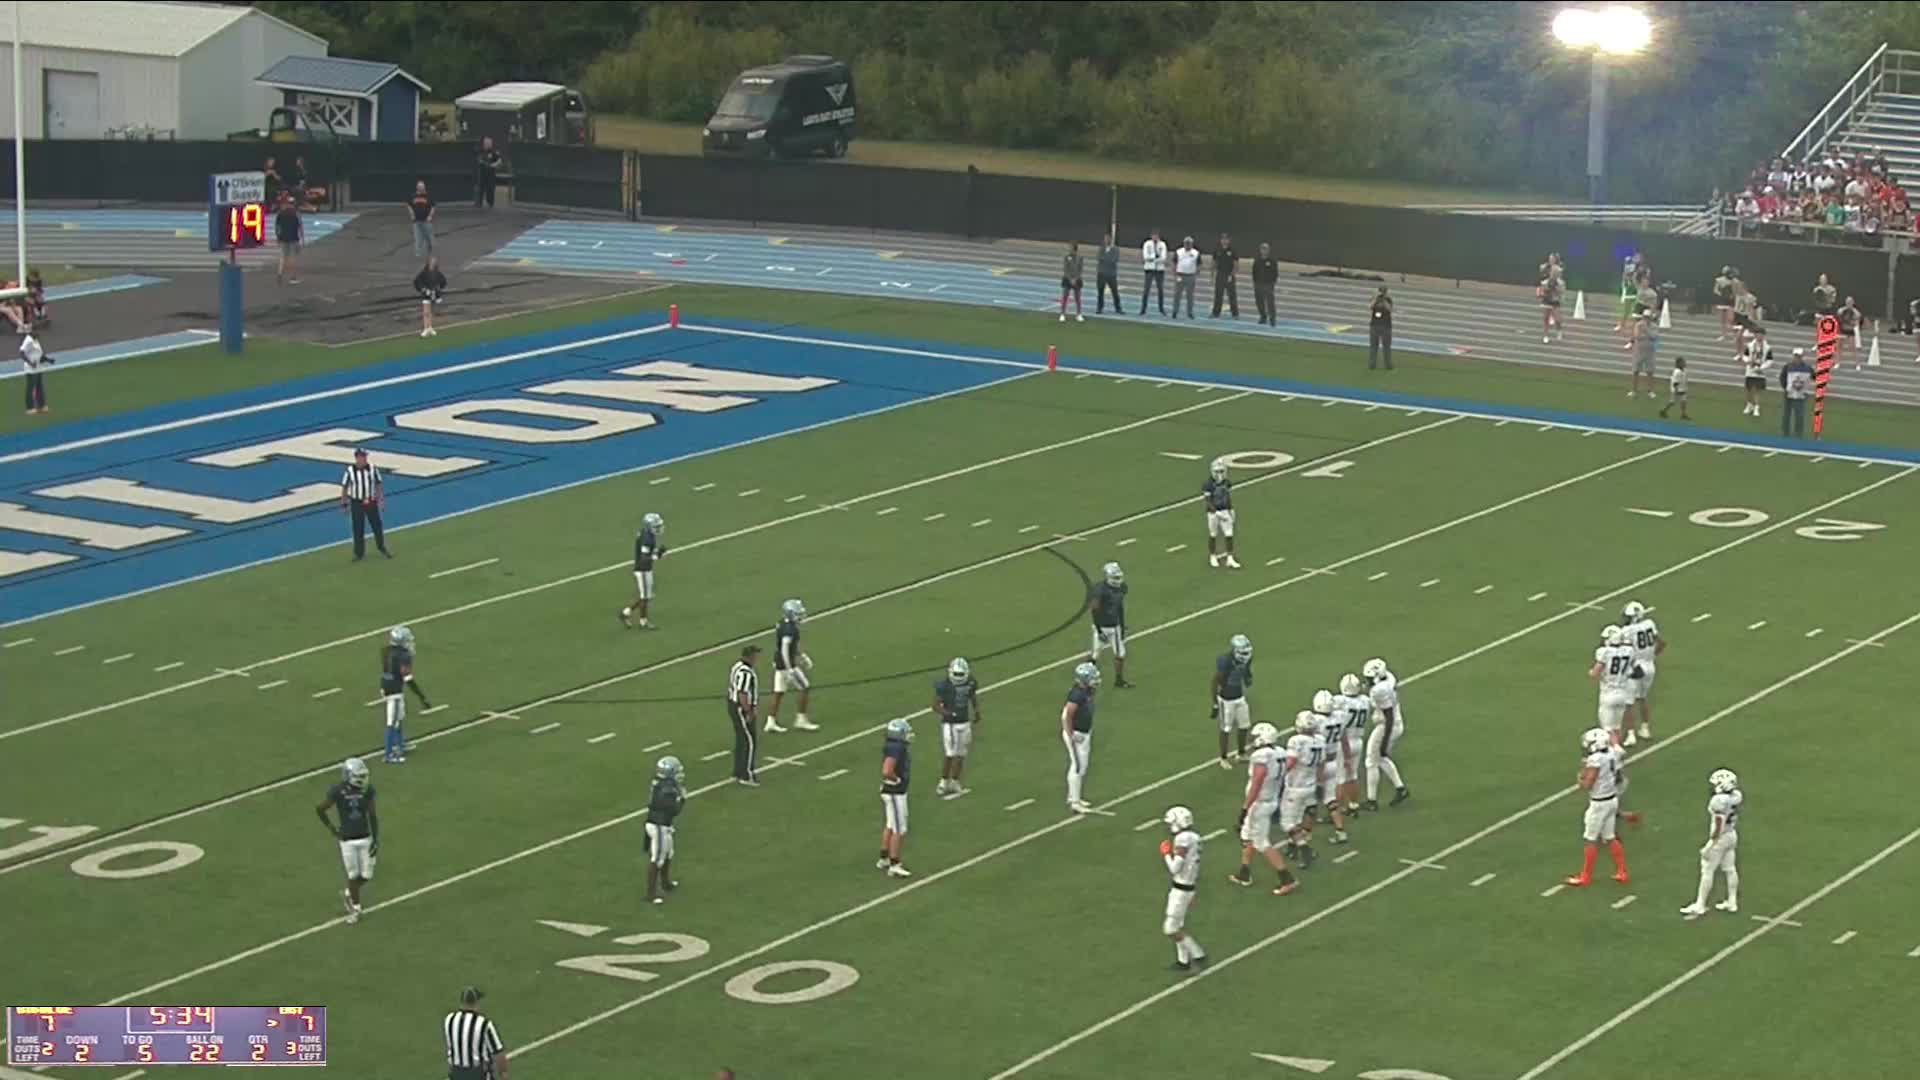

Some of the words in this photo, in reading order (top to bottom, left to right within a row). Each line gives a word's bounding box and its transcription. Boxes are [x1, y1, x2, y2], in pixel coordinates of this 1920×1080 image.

[231, 205, 262, 243] 19
[0, 360, 841, 577] ILTON
[1637, 628, 1655, 649] 80
[1610, 656, 1630, 675] 87
[1347, 708, 1368, 729] 70
[1326, 724, 1342, 743] 72
